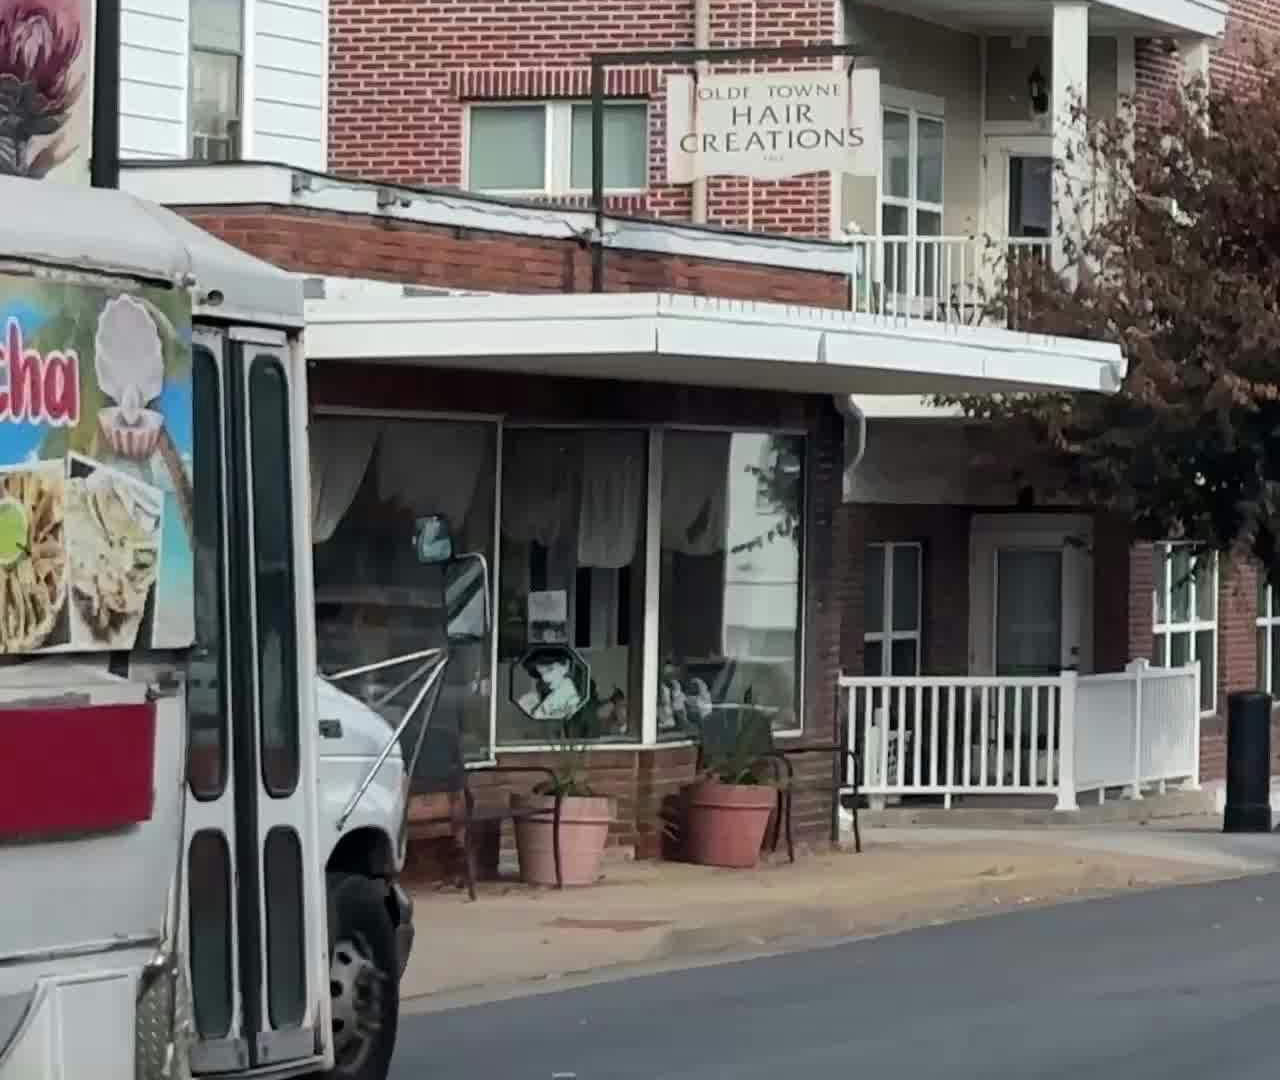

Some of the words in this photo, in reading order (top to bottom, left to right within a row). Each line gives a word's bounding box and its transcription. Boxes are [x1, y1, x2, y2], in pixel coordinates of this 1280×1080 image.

[698, 86, 751, 101] OLDE
[767, 83, 840, 99] TOWNE
[731, 104, 814, 126] HAIR
[679, 127, 865, 154] CREATIONS
